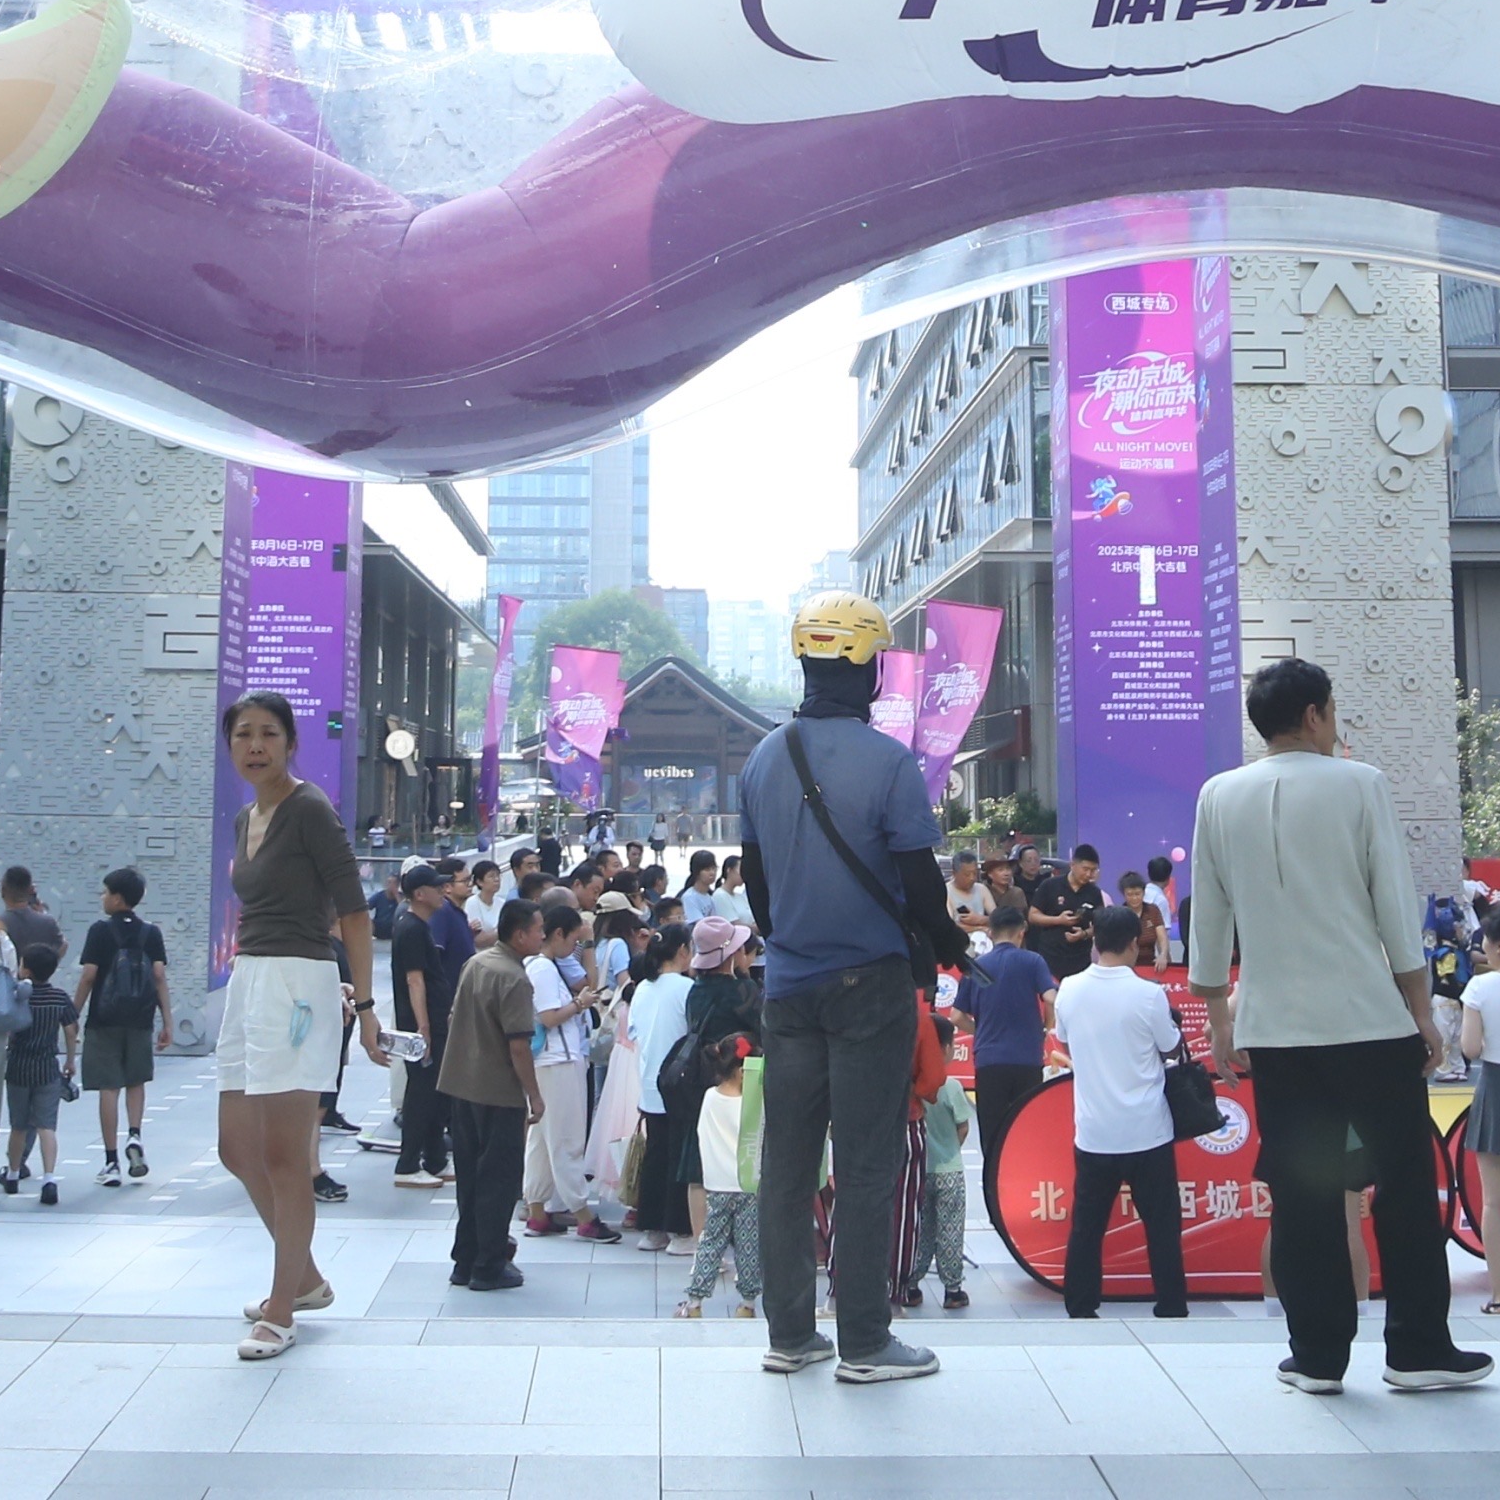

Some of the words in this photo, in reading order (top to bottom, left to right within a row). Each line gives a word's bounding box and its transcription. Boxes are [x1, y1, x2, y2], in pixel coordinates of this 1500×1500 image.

[1111, 296, 1170, 311] 西城专场
[1079, 358, 1194, 400] 夜动京城
[1103, 380, 1196, 421] 潮你而来
[1093, 442, 1114, 452] ALL
[1116, 442, 1151, 452] NIGHT
[1154, 442, 1193, 452] MOVE!
[1111, 561, 1187, 573] 北京中大吉巷
